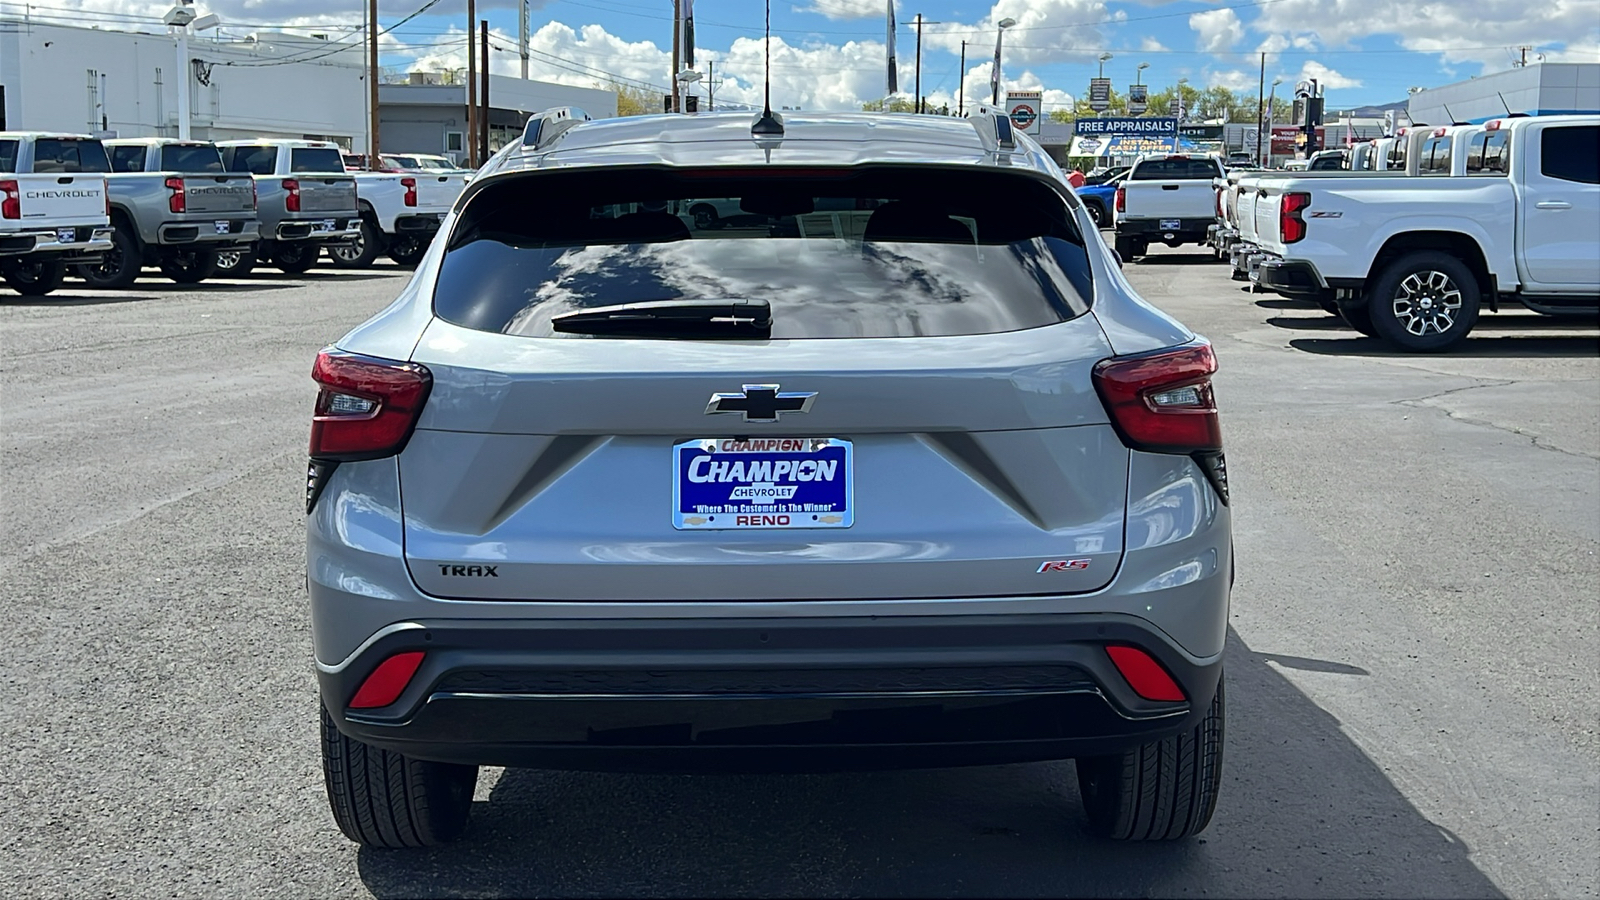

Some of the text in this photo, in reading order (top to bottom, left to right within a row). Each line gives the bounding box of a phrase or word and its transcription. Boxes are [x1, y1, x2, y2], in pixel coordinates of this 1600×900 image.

[1078, 121, 1175, 132] FREE APPRAISALS!
[26, 190, 100, 199] CHEVROLET
[190, 186, 250, 195] CHEVROLET
[721, 439, 804, 452] CHAMPION
[688, 455, 838, 483] CHAMPION
[734, 488, 793, 497] CHEVROLET
[724, 504, 738, 513] The
[740, 504, 776, 513] Customer
[778, 503, 786, 512] Is
[788, 503, 802, 512] The
[736, 515, 790, 526] RENO
[438, 564, 499, 577] TRAX
[1036, 558, 1092, 574] RS
